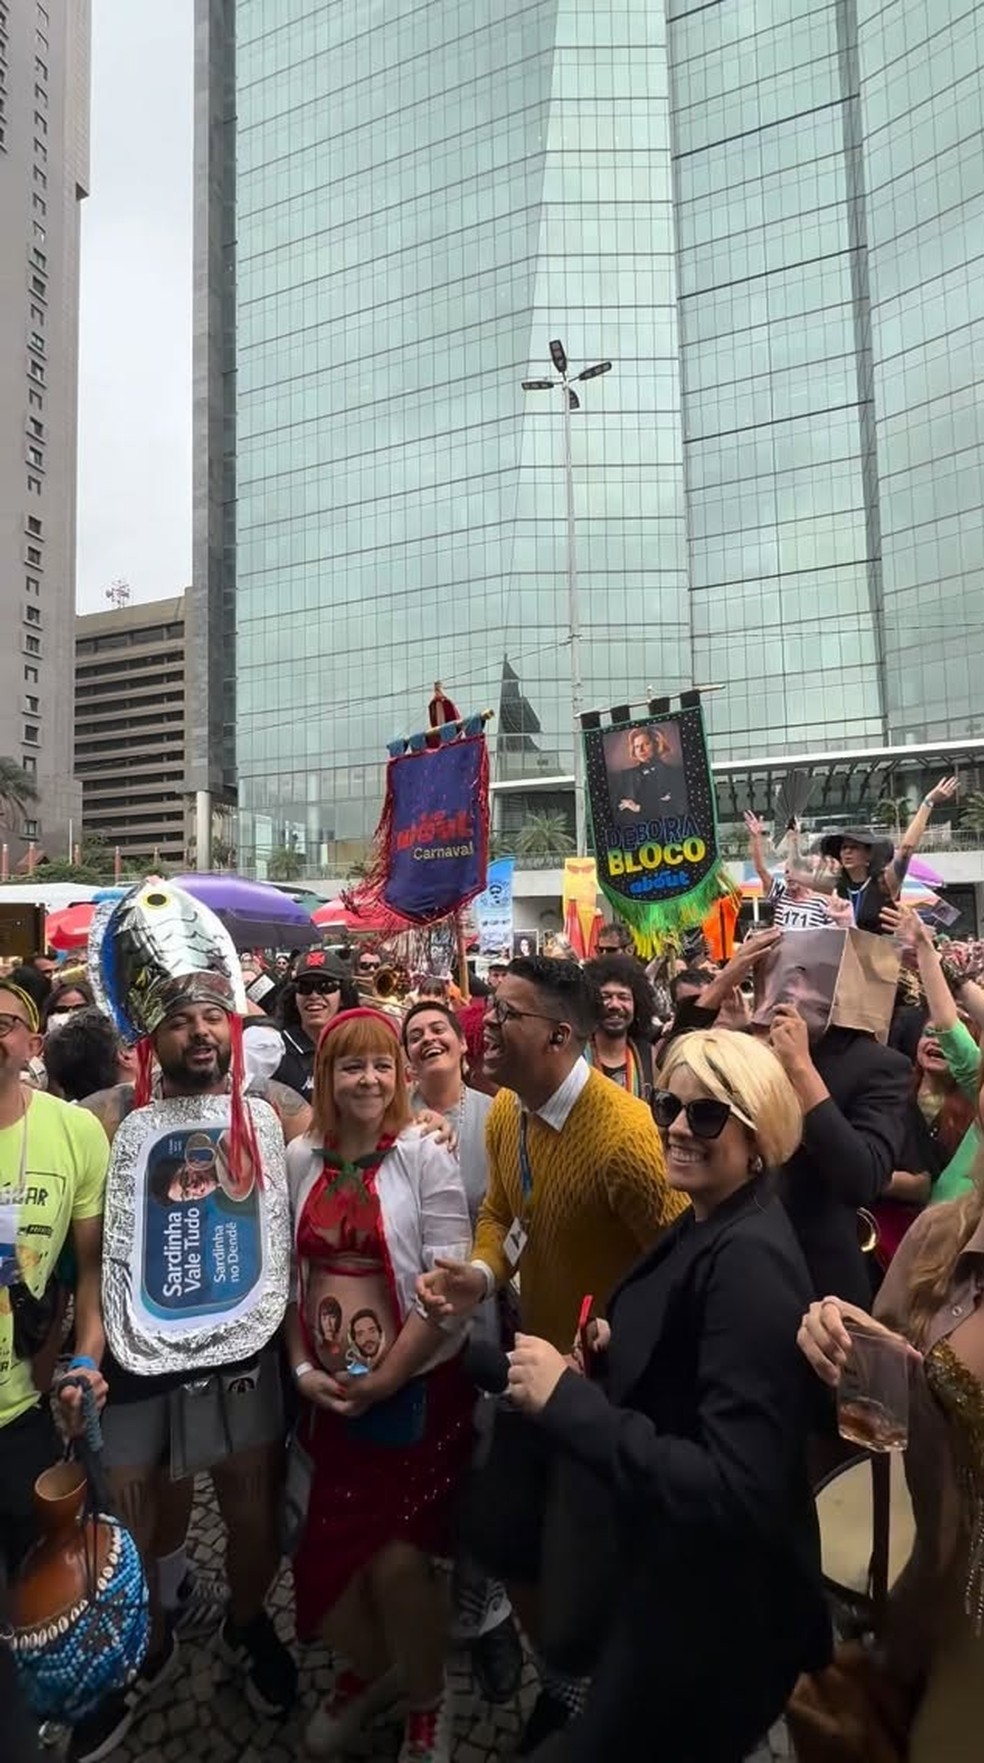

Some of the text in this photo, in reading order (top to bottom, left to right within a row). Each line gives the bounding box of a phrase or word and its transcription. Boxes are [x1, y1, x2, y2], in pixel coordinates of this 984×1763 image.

[413, 840, 474, 860] Carnaval
[607, 836, 706, 876] BLOCO
[783, 911, 807, 928] 171
[162, 1211, 183, 1297] Sardinha
[184, 1207, 202, 1293] Vale Tudo
[212, 1225, 226, 1283] Sardinha
[225, 1222, 240, 1283] no Dendê
